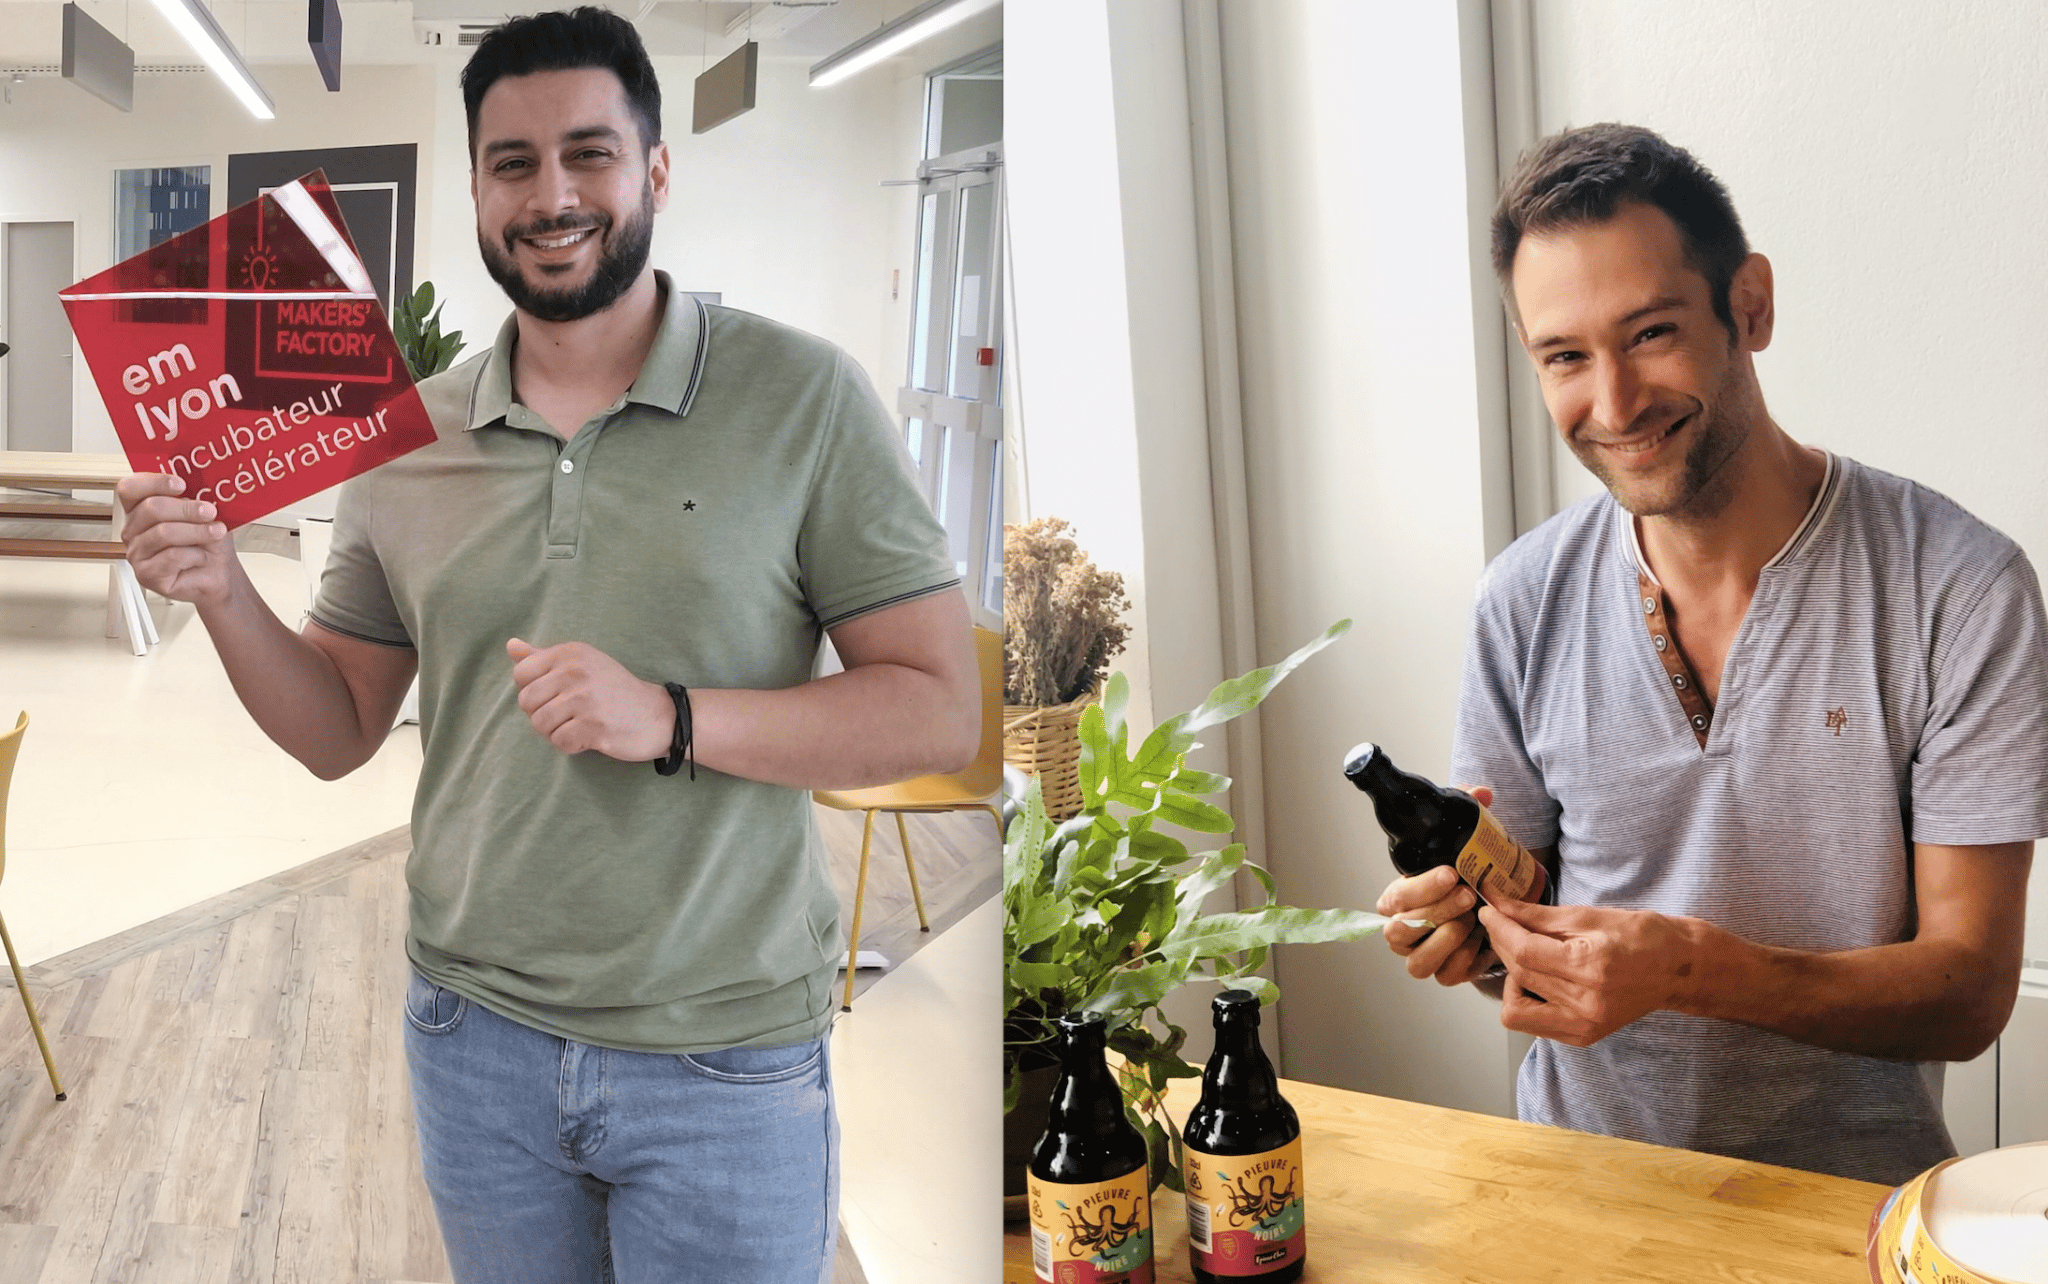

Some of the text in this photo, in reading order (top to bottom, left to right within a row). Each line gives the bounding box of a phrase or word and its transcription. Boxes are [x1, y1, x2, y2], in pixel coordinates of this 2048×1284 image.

[277, 302, 372, 327] MAKERS'
[276, 331, 376, 357] FACTORY
[122, 343, 197, 395] em
[134, 373, 243, 441] lyon
[156, 382, 343, 476] incubateur
[1243, 1158, 1289, 1180] PIEUVRE
[1083, 1188, 1131, 1209] PIEUVRE
[1253, 1224, 1286, 1241] NOIRE
[1094, 1255, 1129, 1272] NOIRE
